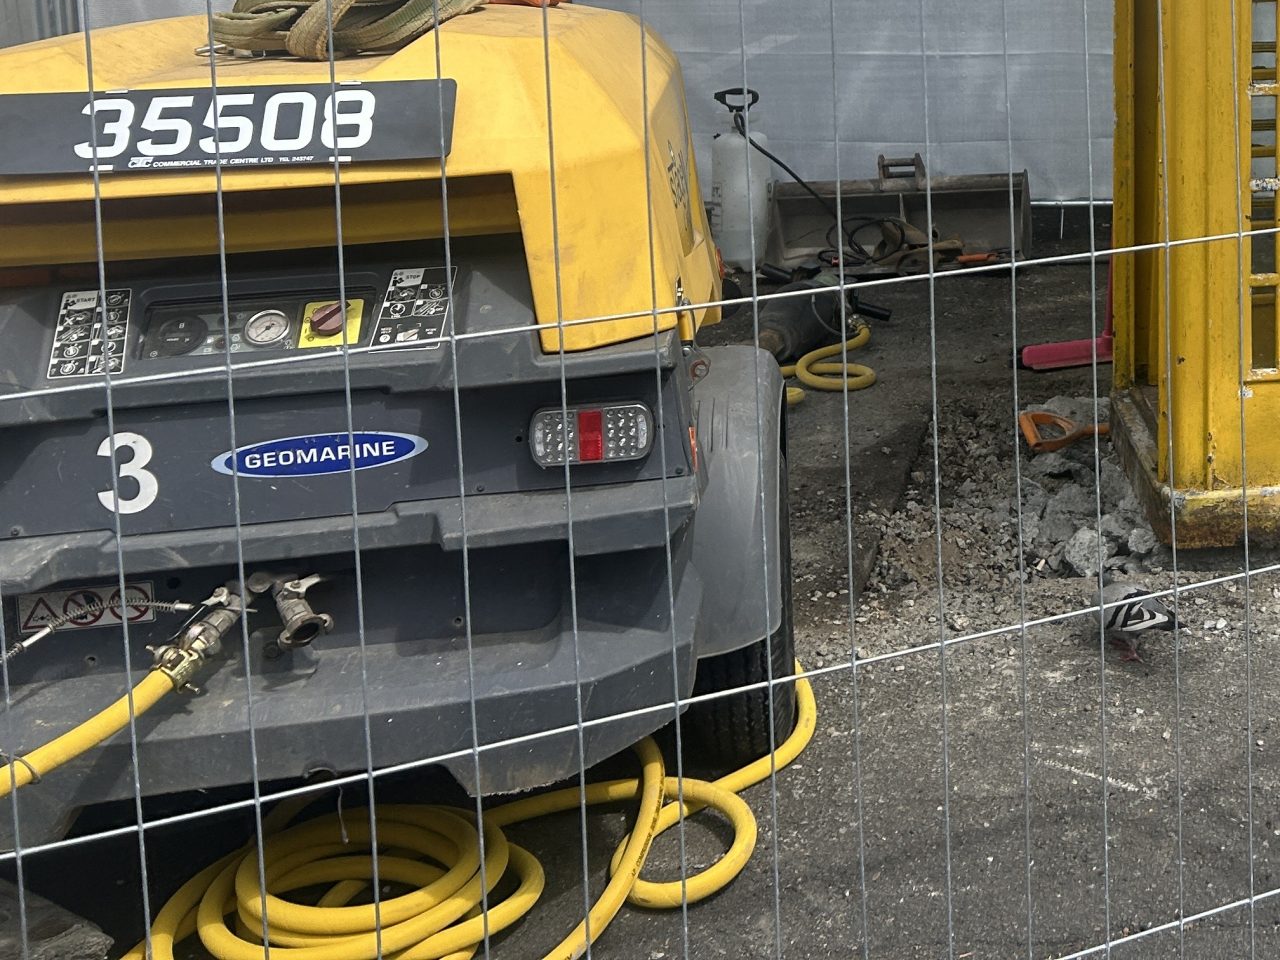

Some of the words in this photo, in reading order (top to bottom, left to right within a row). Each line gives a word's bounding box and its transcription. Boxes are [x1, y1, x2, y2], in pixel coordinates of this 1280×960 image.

[74, 90, 376, 159] 35508
[153, 159, 202, 168] COMMERCIAL
[230, 157, 259, 165] CENTRE
[96, 431, 158, 515] 3
[244, 441, 396, 469] GEOMARINE
